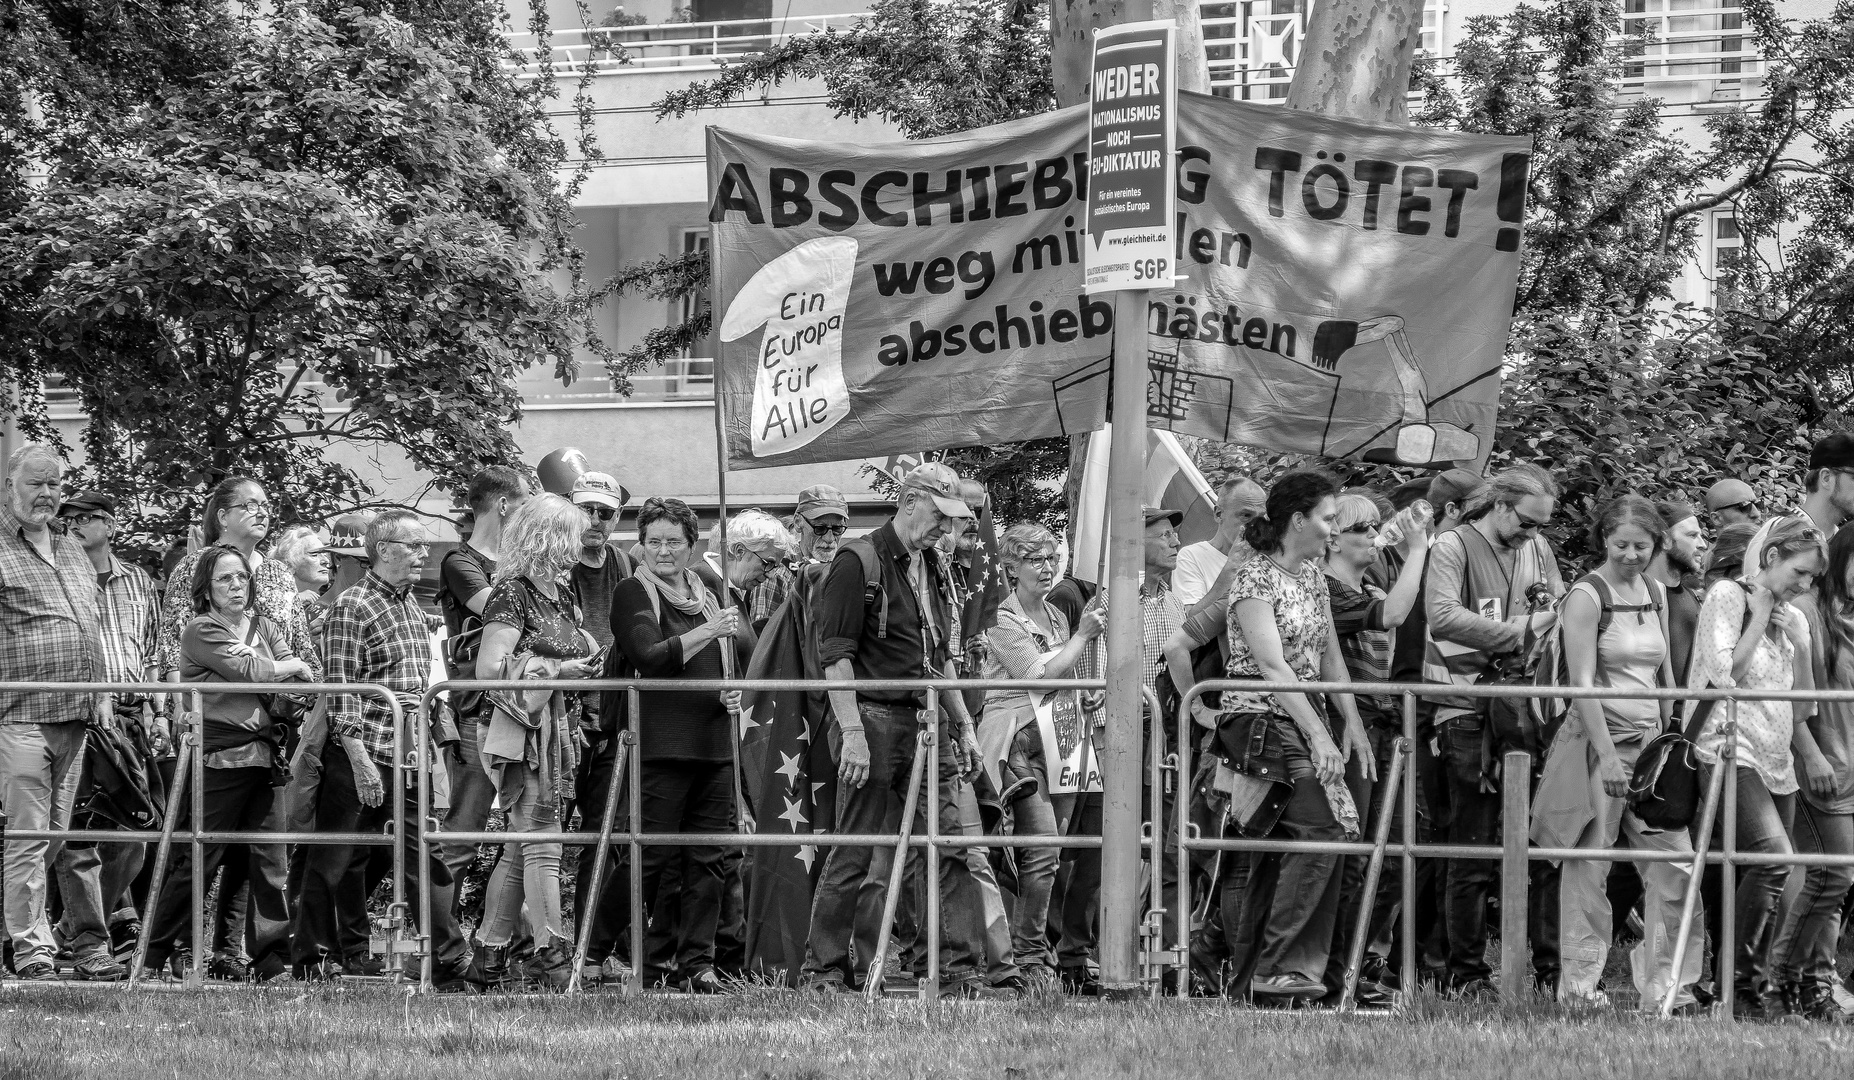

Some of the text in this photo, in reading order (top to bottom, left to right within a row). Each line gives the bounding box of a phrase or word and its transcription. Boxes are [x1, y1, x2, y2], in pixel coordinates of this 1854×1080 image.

[1095, 62, 1160, 102] WEDER
[1093, 105, 1161, 128] NATIONALISMUS
[1107, 130, 1131, 147] NOCH
[1092, 150, 1161, 176] EU-DIKTATUR
[709, 146, 1211, 232] ABSCHIEBG
[1106, 189, 1114, 200] ein
[1114, 187, 1142, 199] vereintes
[1094, 201, 1150, 216] sozialistisches Europa
[1108, 233, 1167, 246] www.gleichheit.de
[872, 211, 1252, 300] weg mi en
[1134, 258, 1168, 280] SGP
[780, 291, 825, 321] Ein
[764, 314, 841, 370] Europa
[877, 294, 1297, 367] abschiebnästen
[772, 363, 818, 397] für
[761, 397, 829, 441] Alle
[1056, 701, 1074, 712] Ein
[1060, 738, 1074, 749] Alle
